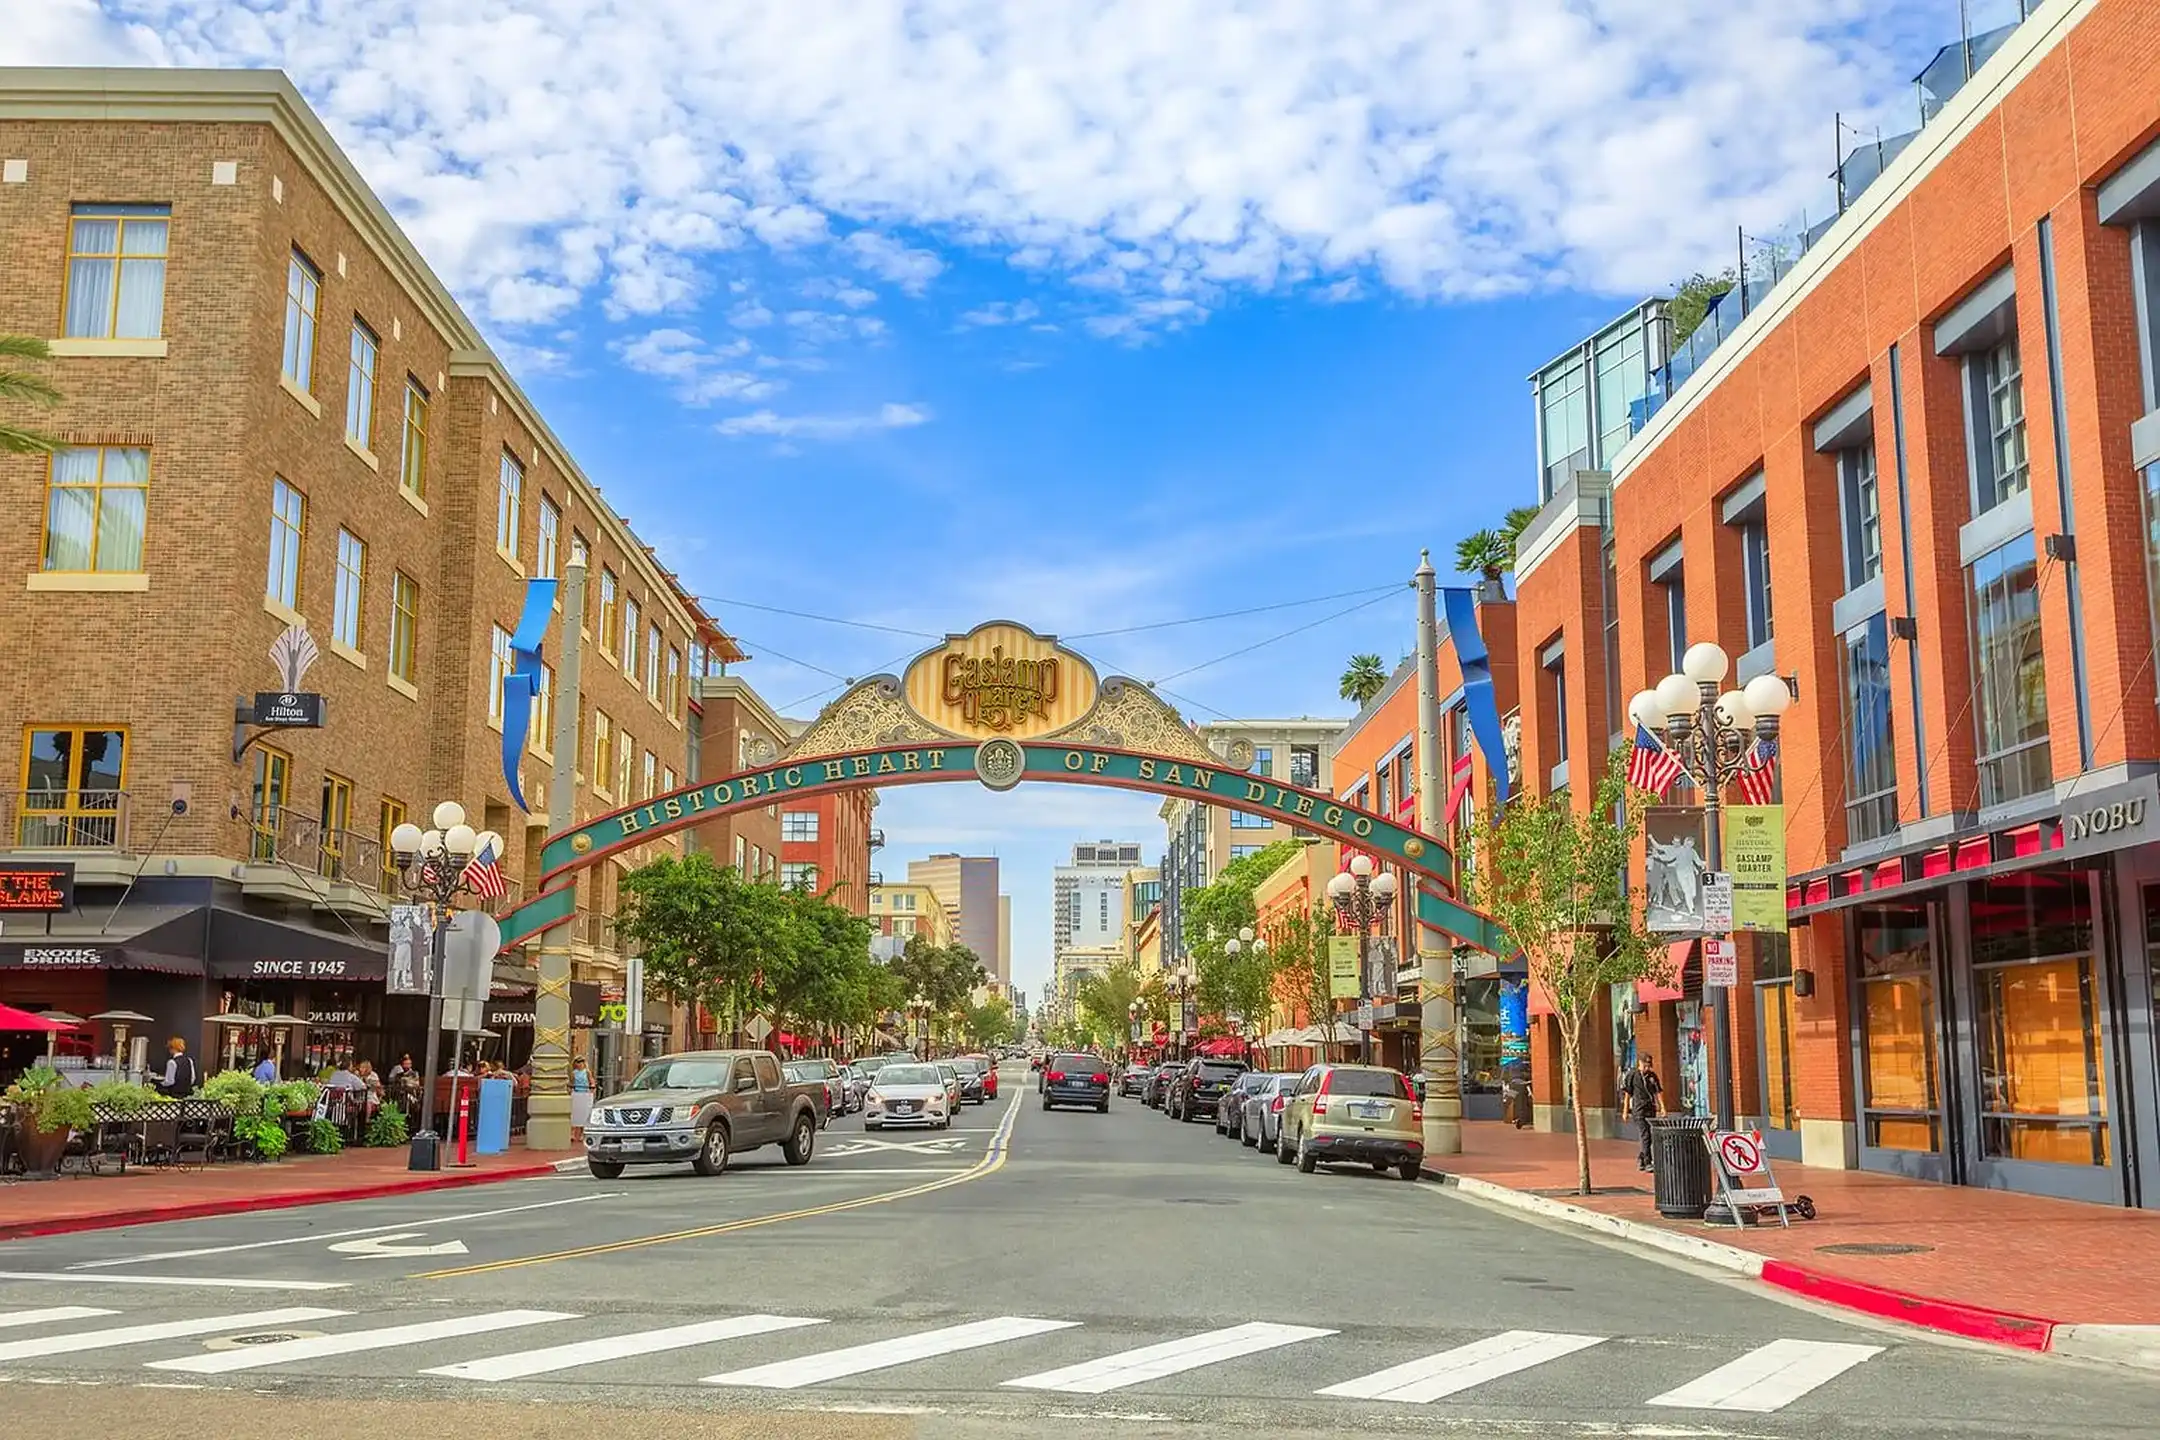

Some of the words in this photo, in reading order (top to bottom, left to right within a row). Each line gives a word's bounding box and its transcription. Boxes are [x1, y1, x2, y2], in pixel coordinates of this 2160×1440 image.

[942, 645, 1060, 706] Gaslamp
[271, 706, 304, 717] Hilton
[617, 767, 803, 836] HISTORIC
[823, 750, 946, 781] HEART
[1064, 751, 1110, 773] OF
[1138, 759, 1215, 790] SAN
[1244, 782, 1373, 837] DIEGO
[2070, 797, 2148, 840] NOBU
[1735, 854, 1773, 863] GASLAMP
[1736, 863, 1772, 873] QUARTER
[11, 876, 49, 890] THE
[24, 948, 97, 957] EXOTIC
[1706, 943, 1718, 954] NO
[23, 955, 101, 964] DRINKS
[1707, 956, 1734, 966] PARKING
[253, 961, 303, 974] SINCE
[309, 961, 346, 975] 1945
[491, 1012, 537, 1024] ENTRAN
